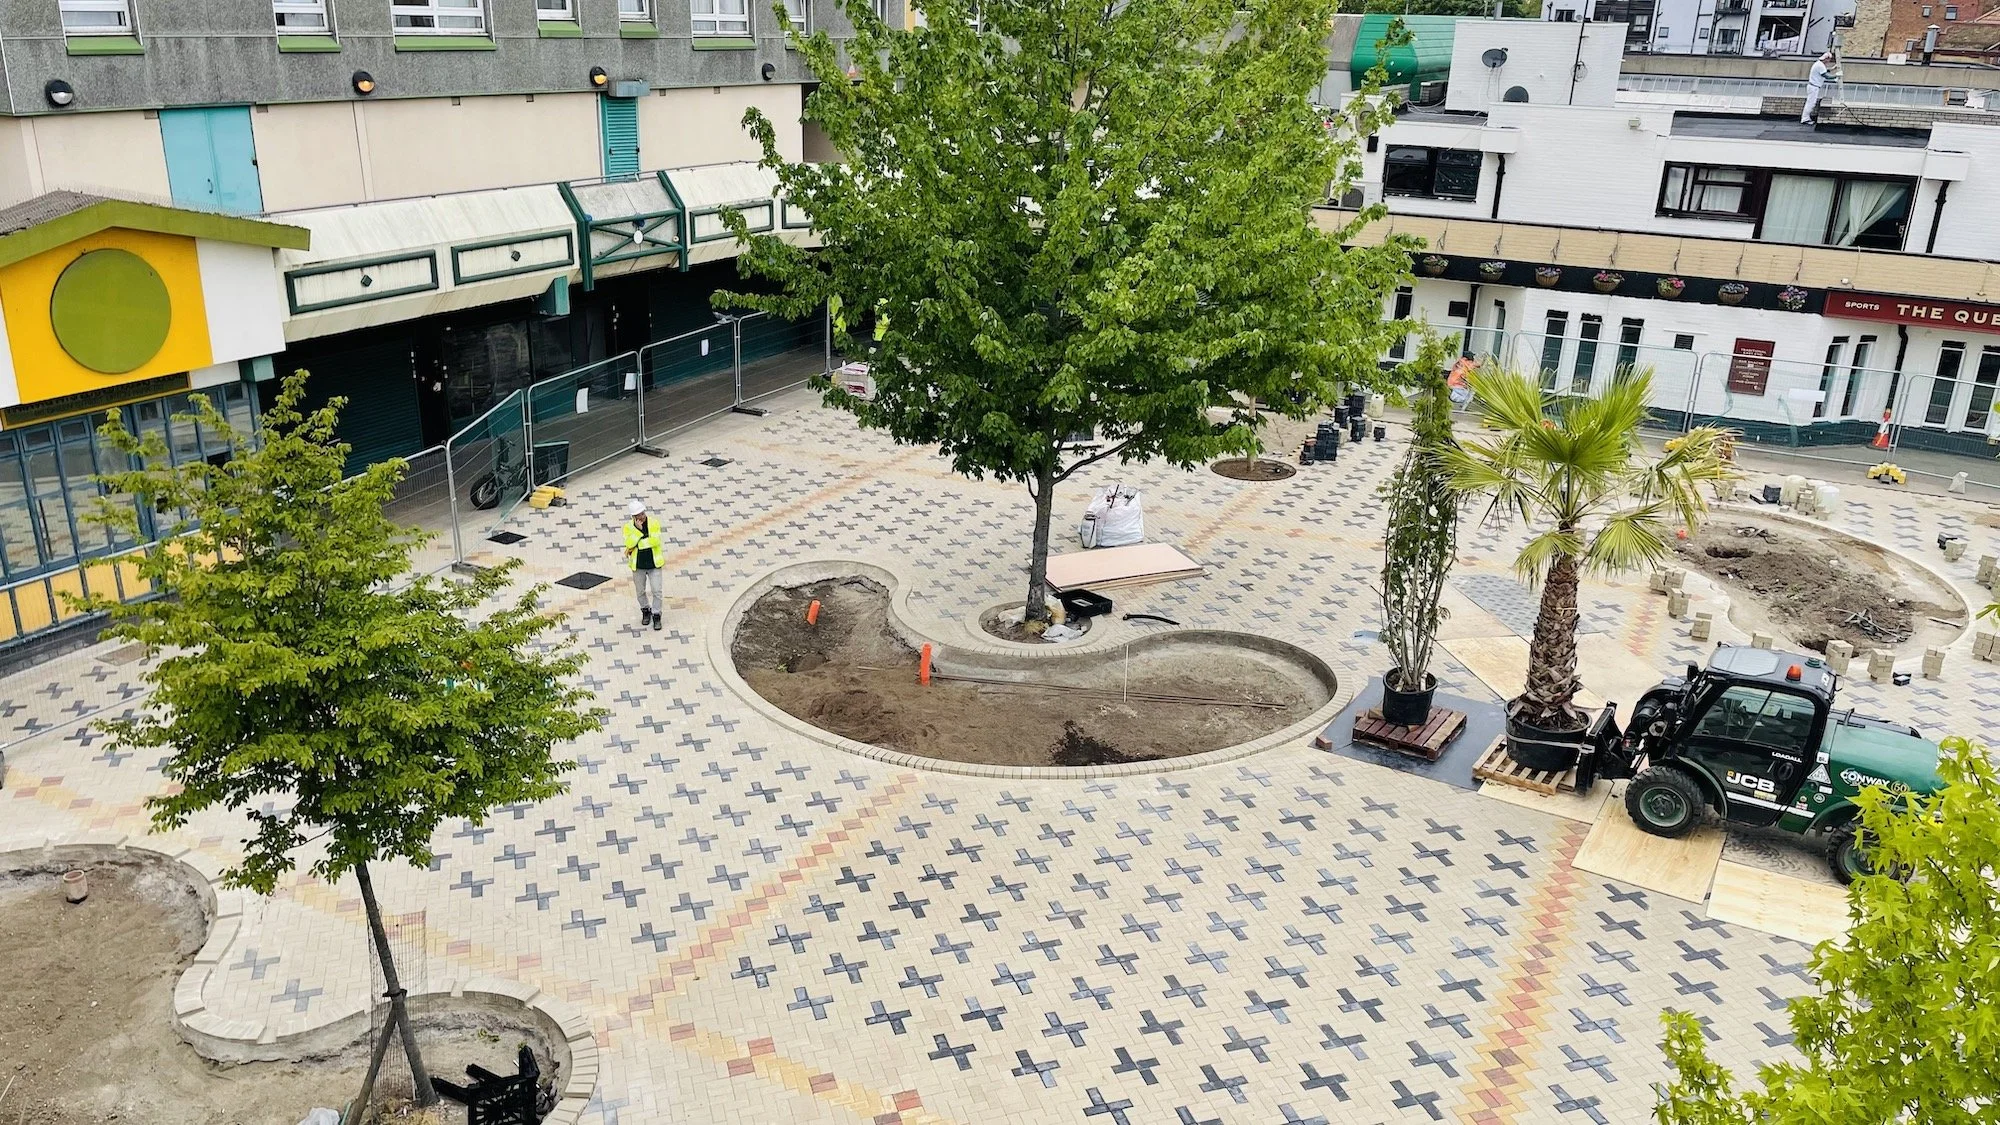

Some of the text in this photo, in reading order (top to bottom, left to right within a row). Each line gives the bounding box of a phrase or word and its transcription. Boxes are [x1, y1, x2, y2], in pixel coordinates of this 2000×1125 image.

[1844, 301, 1880, 311] SPORTS
[1897, 303, 1945, 320] THE
[1771, 751, 1802, 763] LOADALL
[1726, 771, 1775, 793] JCB
[1839, 768, 1890, 788] CONWAY
